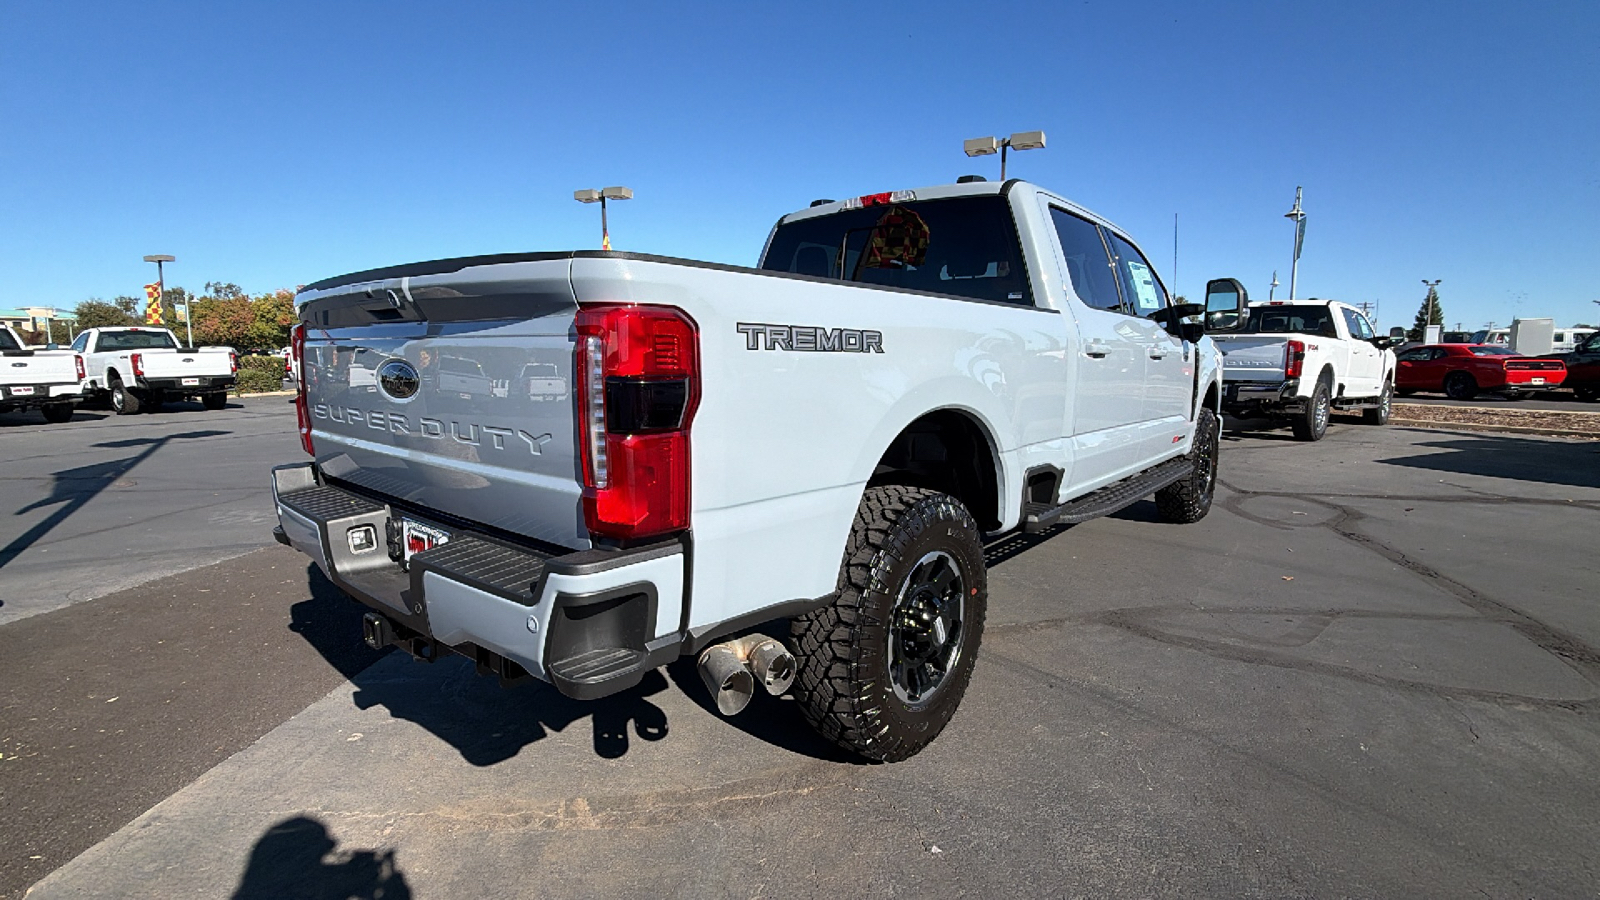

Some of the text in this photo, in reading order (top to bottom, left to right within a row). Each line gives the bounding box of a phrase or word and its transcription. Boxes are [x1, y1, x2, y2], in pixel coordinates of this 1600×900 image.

[736, 322, 885, 353] TREMOR
[314, 403, 552, 455] SUPER DUTY
